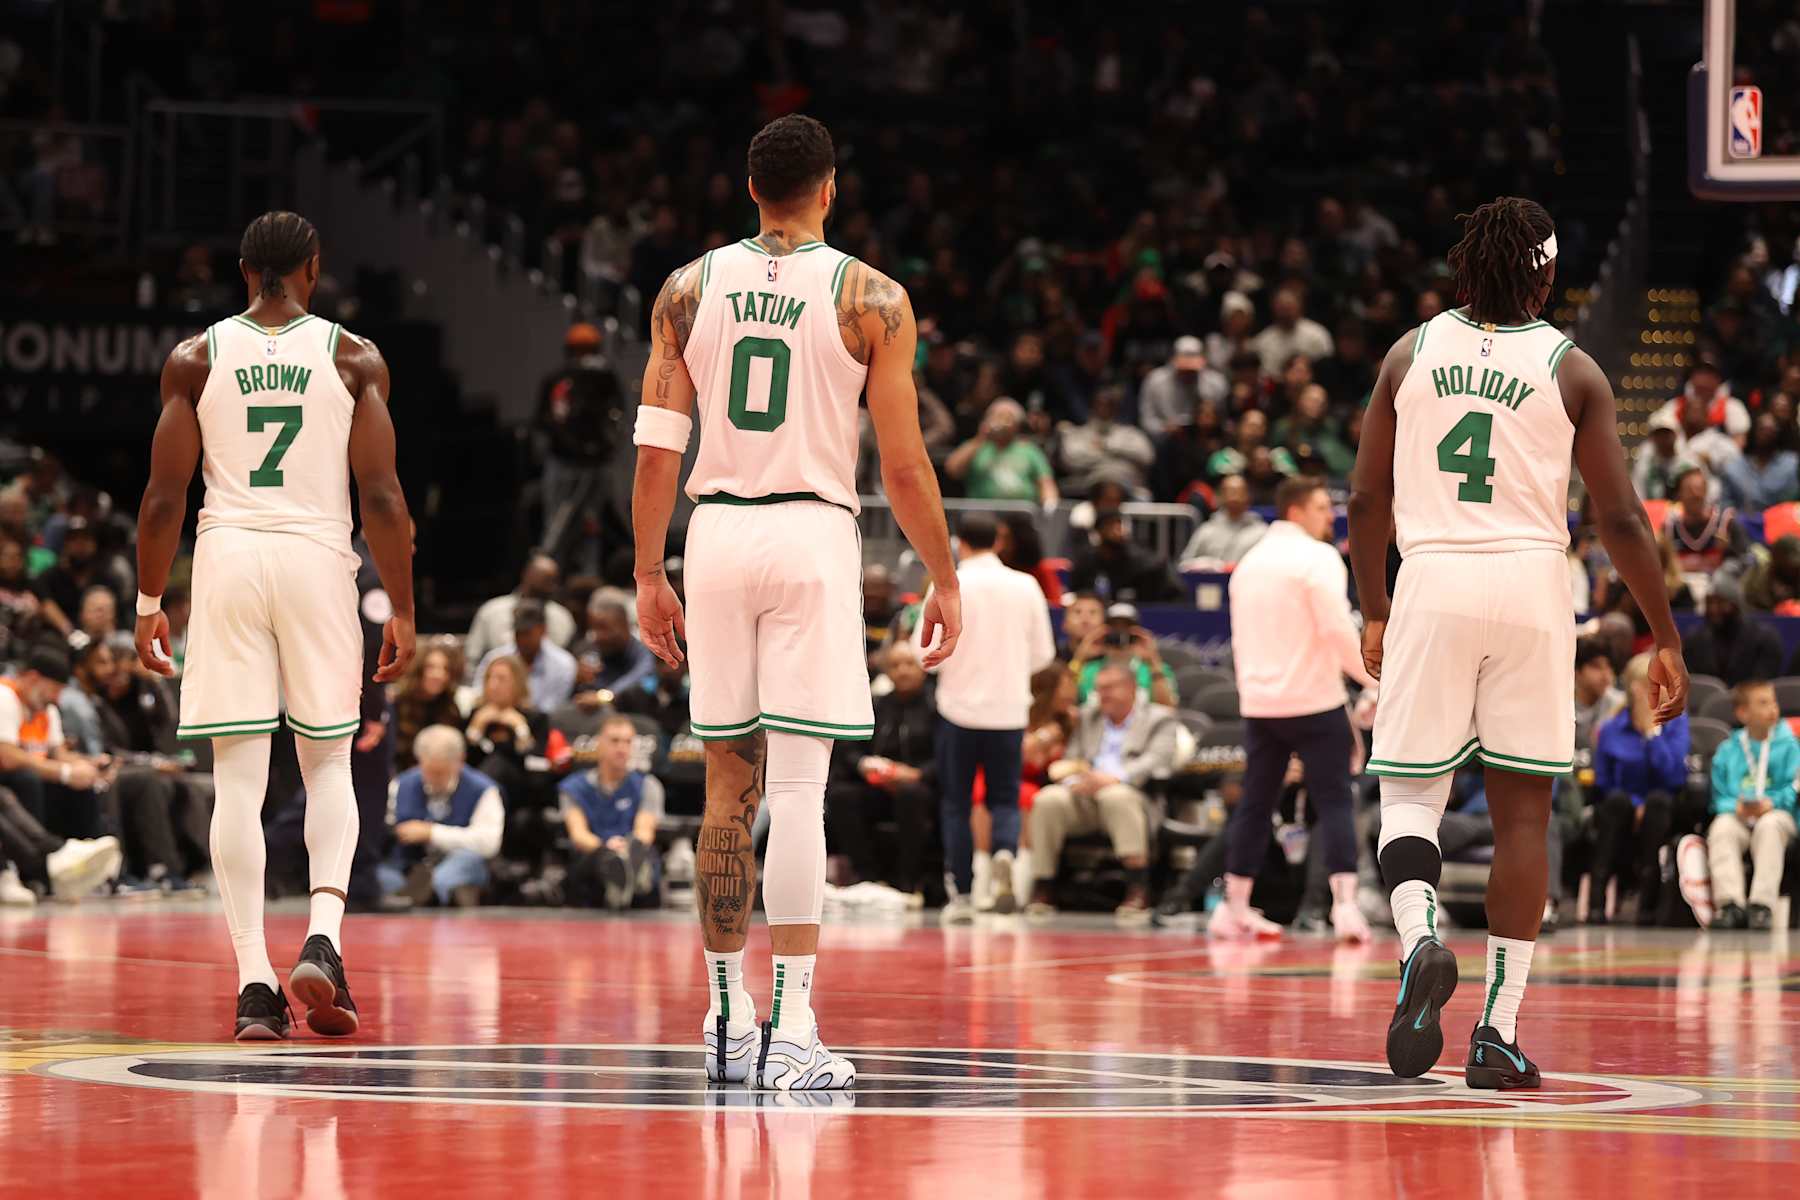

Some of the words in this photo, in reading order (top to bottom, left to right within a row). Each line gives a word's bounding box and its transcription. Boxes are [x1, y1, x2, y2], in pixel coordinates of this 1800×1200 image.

[726, 291, 806, 330] TATUM
[0, 321, 182, 376] ONUM
[235, 363, 312, 395] BROWN
[728, 336, 791, 432] 0
[1432, 365, 1535, 411] HOLIDAY
[247, 405, 303, 487] 7
[1437, 411, 1496, 503] 4
[704, 828, 738, 850] JUST
